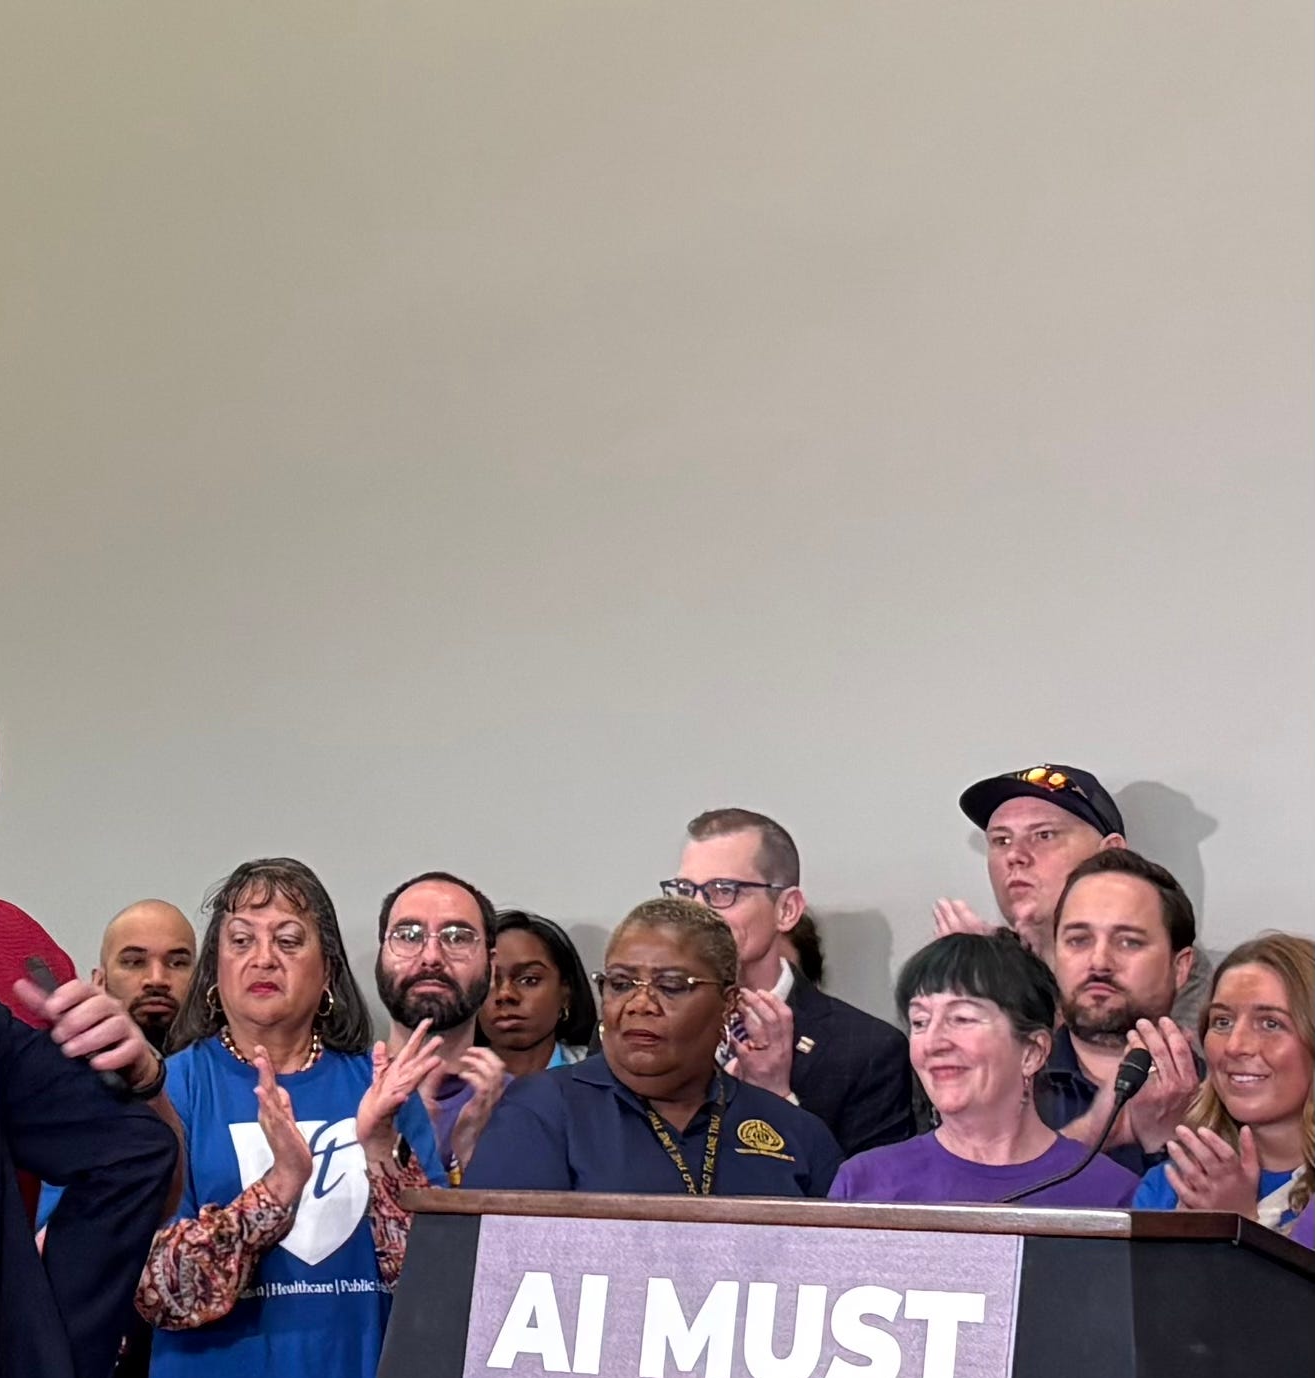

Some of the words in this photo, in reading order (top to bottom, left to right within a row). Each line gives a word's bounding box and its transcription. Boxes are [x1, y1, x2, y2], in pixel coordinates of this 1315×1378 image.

[271, 1280, 334, 1295] Healthcare
[341, 1278, 375, 1292] Public
[486, 1270, 610, 1375] AI
